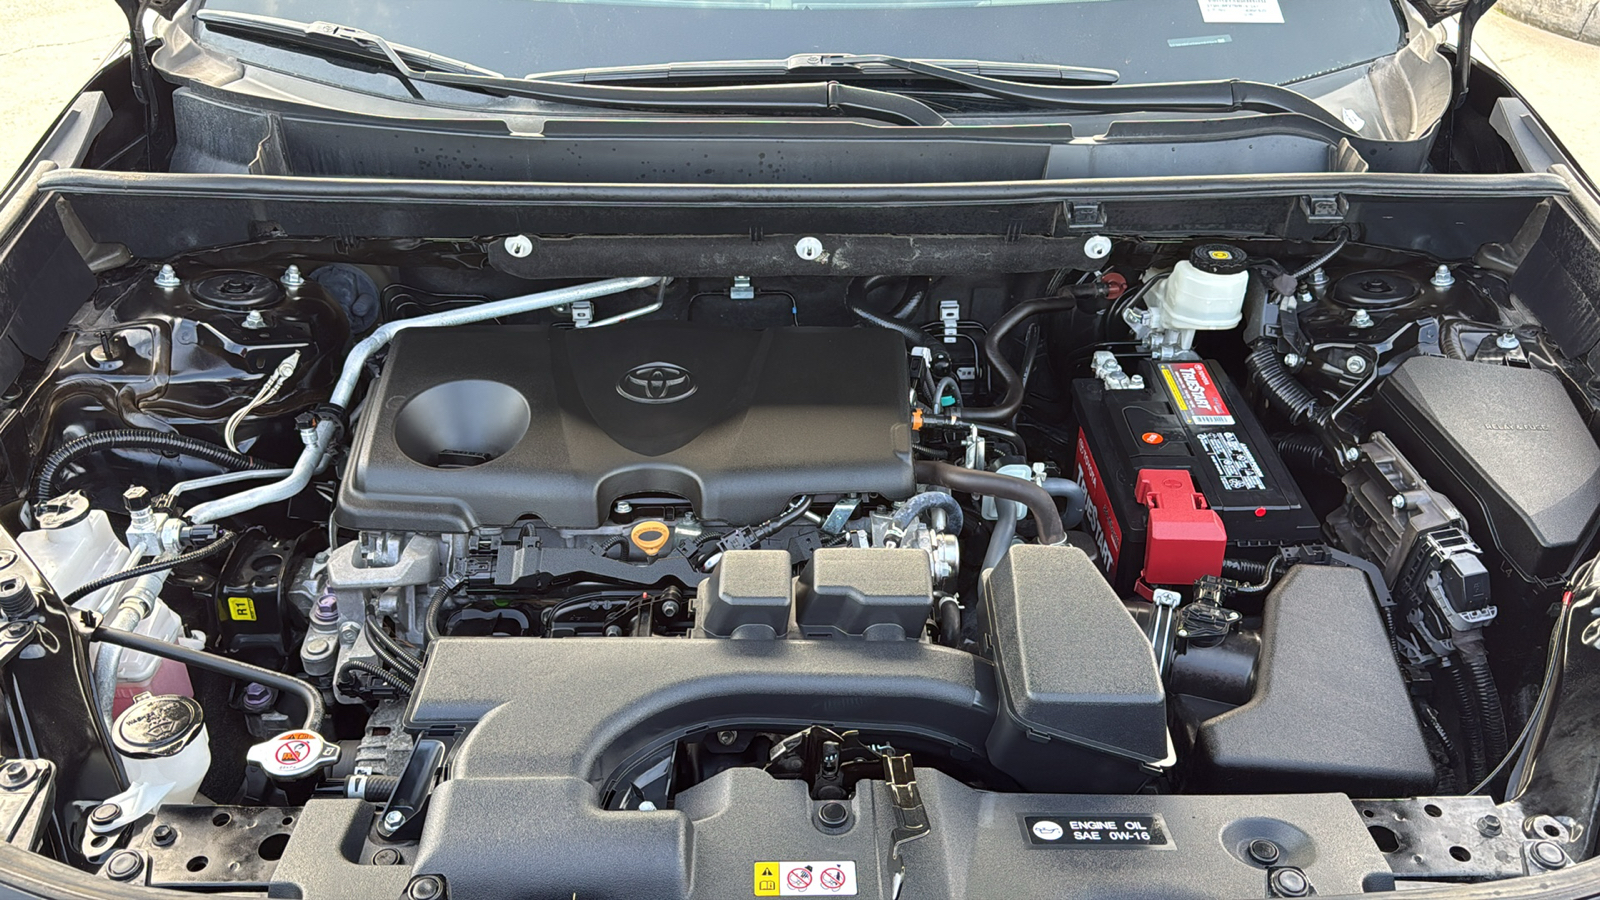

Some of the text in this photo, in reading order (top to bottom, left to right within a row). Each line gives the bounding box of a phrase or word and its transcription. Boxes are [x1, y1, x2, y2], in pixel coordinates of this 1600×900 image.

[235, 602, 248, 616] R1
[1069, 821, 1148, 830] ENGINE OIL
[1073, 831, 1151, 841] SAE 0W-16
